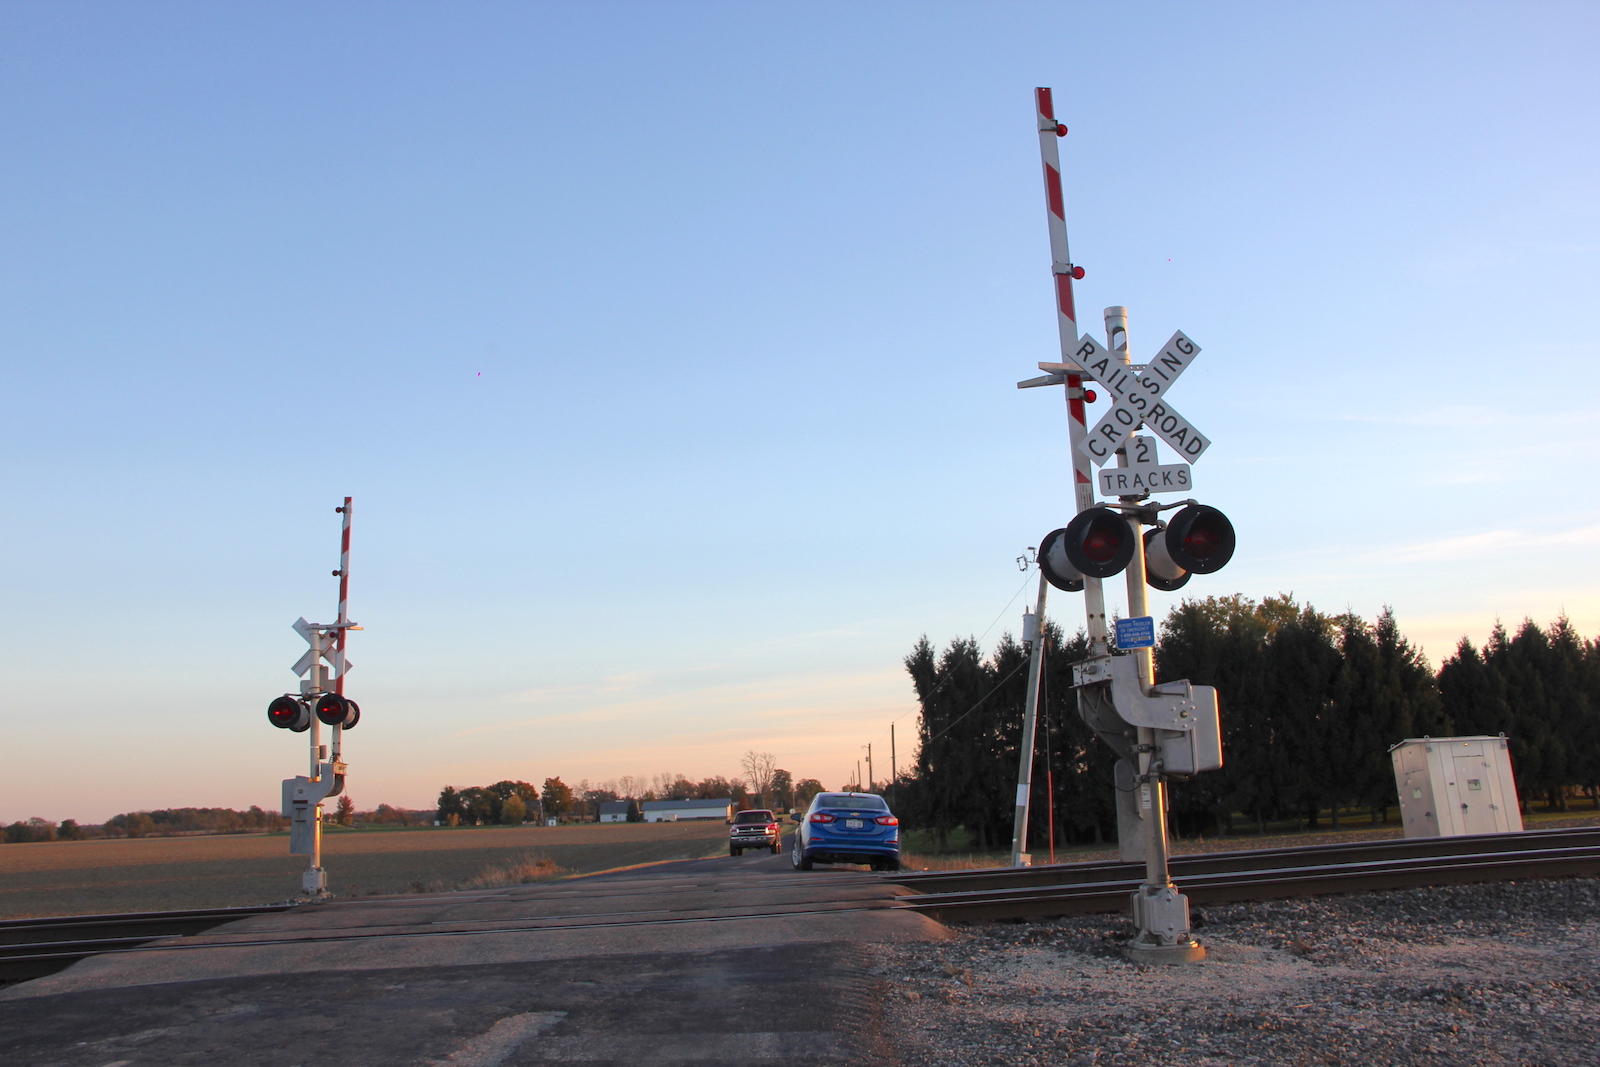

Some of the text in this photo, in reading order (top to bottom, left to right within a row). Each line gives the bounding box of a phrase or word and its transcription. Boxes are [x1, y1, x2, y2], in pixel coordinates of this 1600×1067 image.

[1088, 337, 1194, 457] CROSSING
[1135, 443, 1150, 463] 2
[1104, 470, 1188, 490] TRACKS
